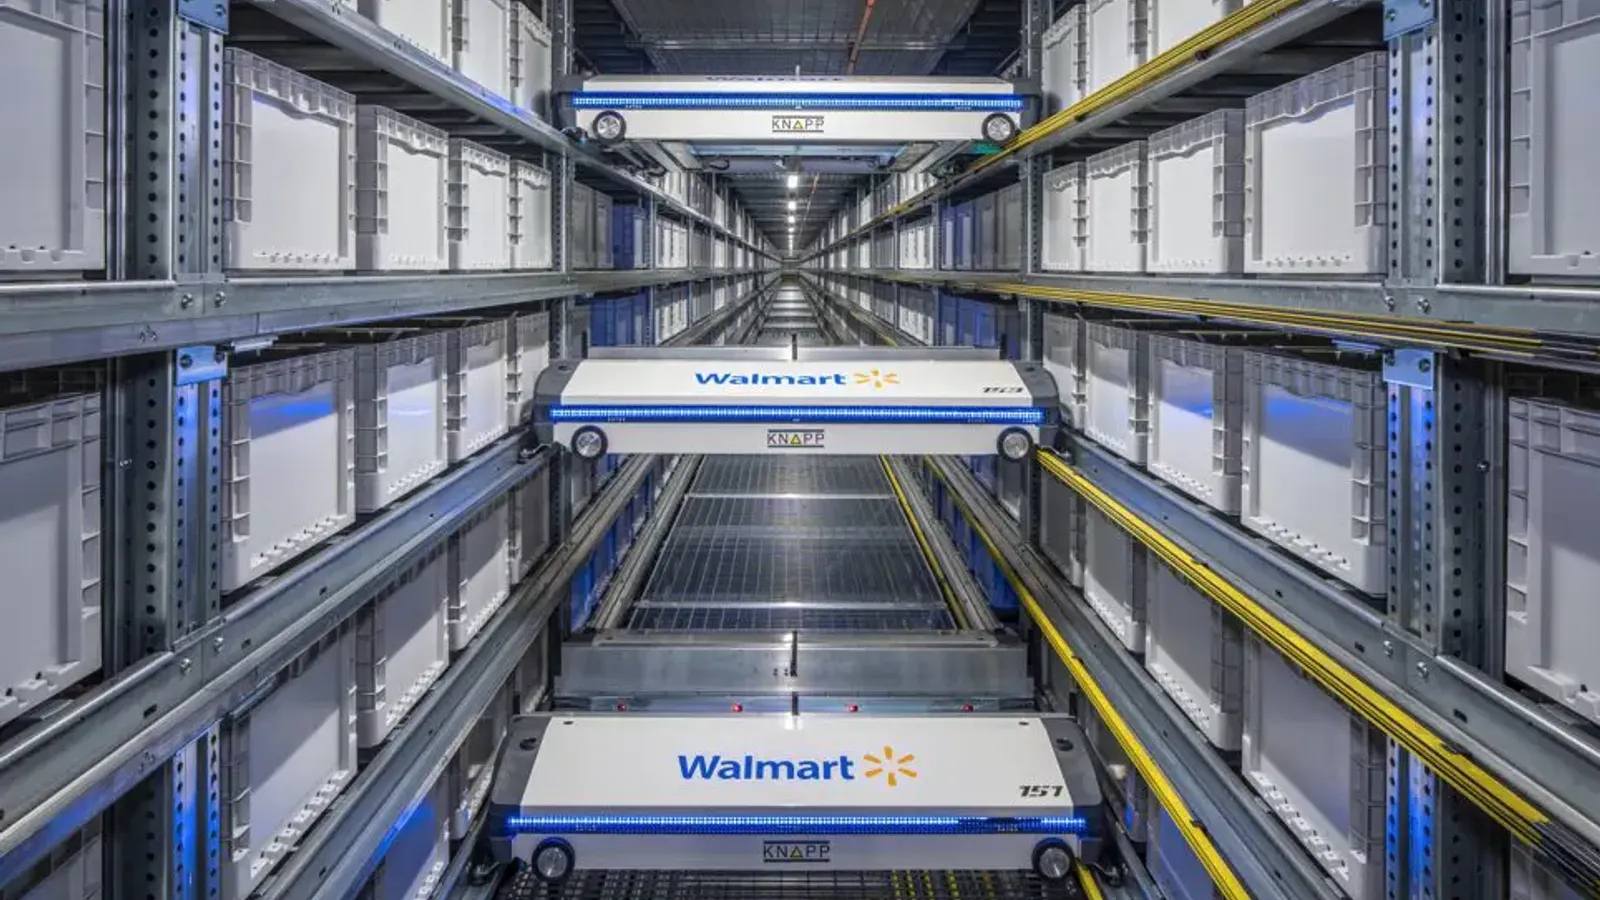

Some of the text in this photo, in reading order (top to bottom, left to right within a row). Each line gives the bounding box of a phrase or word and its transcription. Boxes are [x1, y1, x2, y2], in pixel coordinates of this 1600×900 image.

[772, 117, 824, 129] KNAPP
[696, 372, 847, 386] Walmart
[767, 433, 825, 445] KNAPP
[678, 754, 855, 782] Walmart
[1019, 784, 1065, 797] 151
[763, 845, 831, 857] KNAPP
